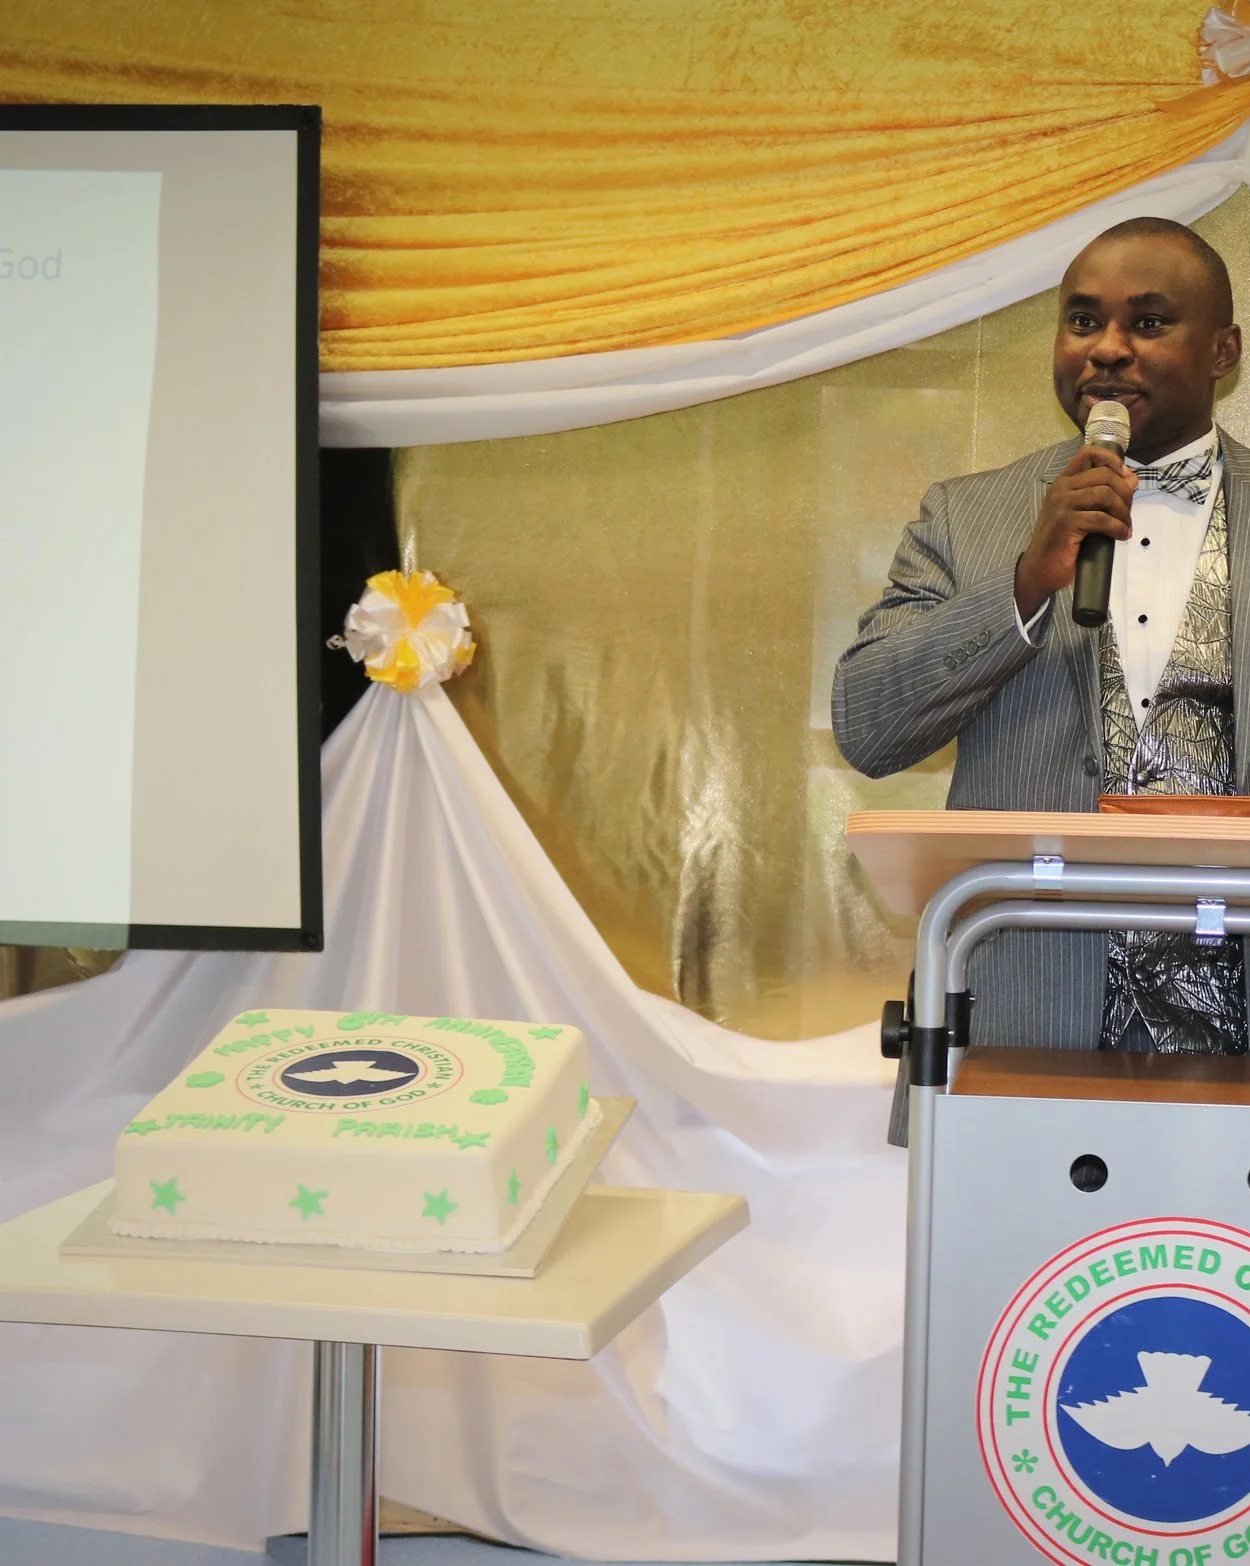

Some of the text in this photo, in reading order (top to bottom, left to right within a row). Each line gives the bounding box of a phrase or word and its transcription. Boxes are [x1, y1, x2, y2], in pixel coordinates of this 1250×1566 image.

[213, 1023, 315, 1056] HAPPY
[246, 1039, 454, 1081] THE REDEEMED CHRISTIAN
[258, 1089, 426, 1110] CHURCH OF GOD
[163, 1113, 458, 1139] TRINITY PARISH
[1006, 1349, 1039, 1426] THE
[1027, 1244, 1222, 1341] REDEEMED
[1031, 1485, 1159, 1566] CHURCH
[1169, 1544, 1212, 1566] OF
